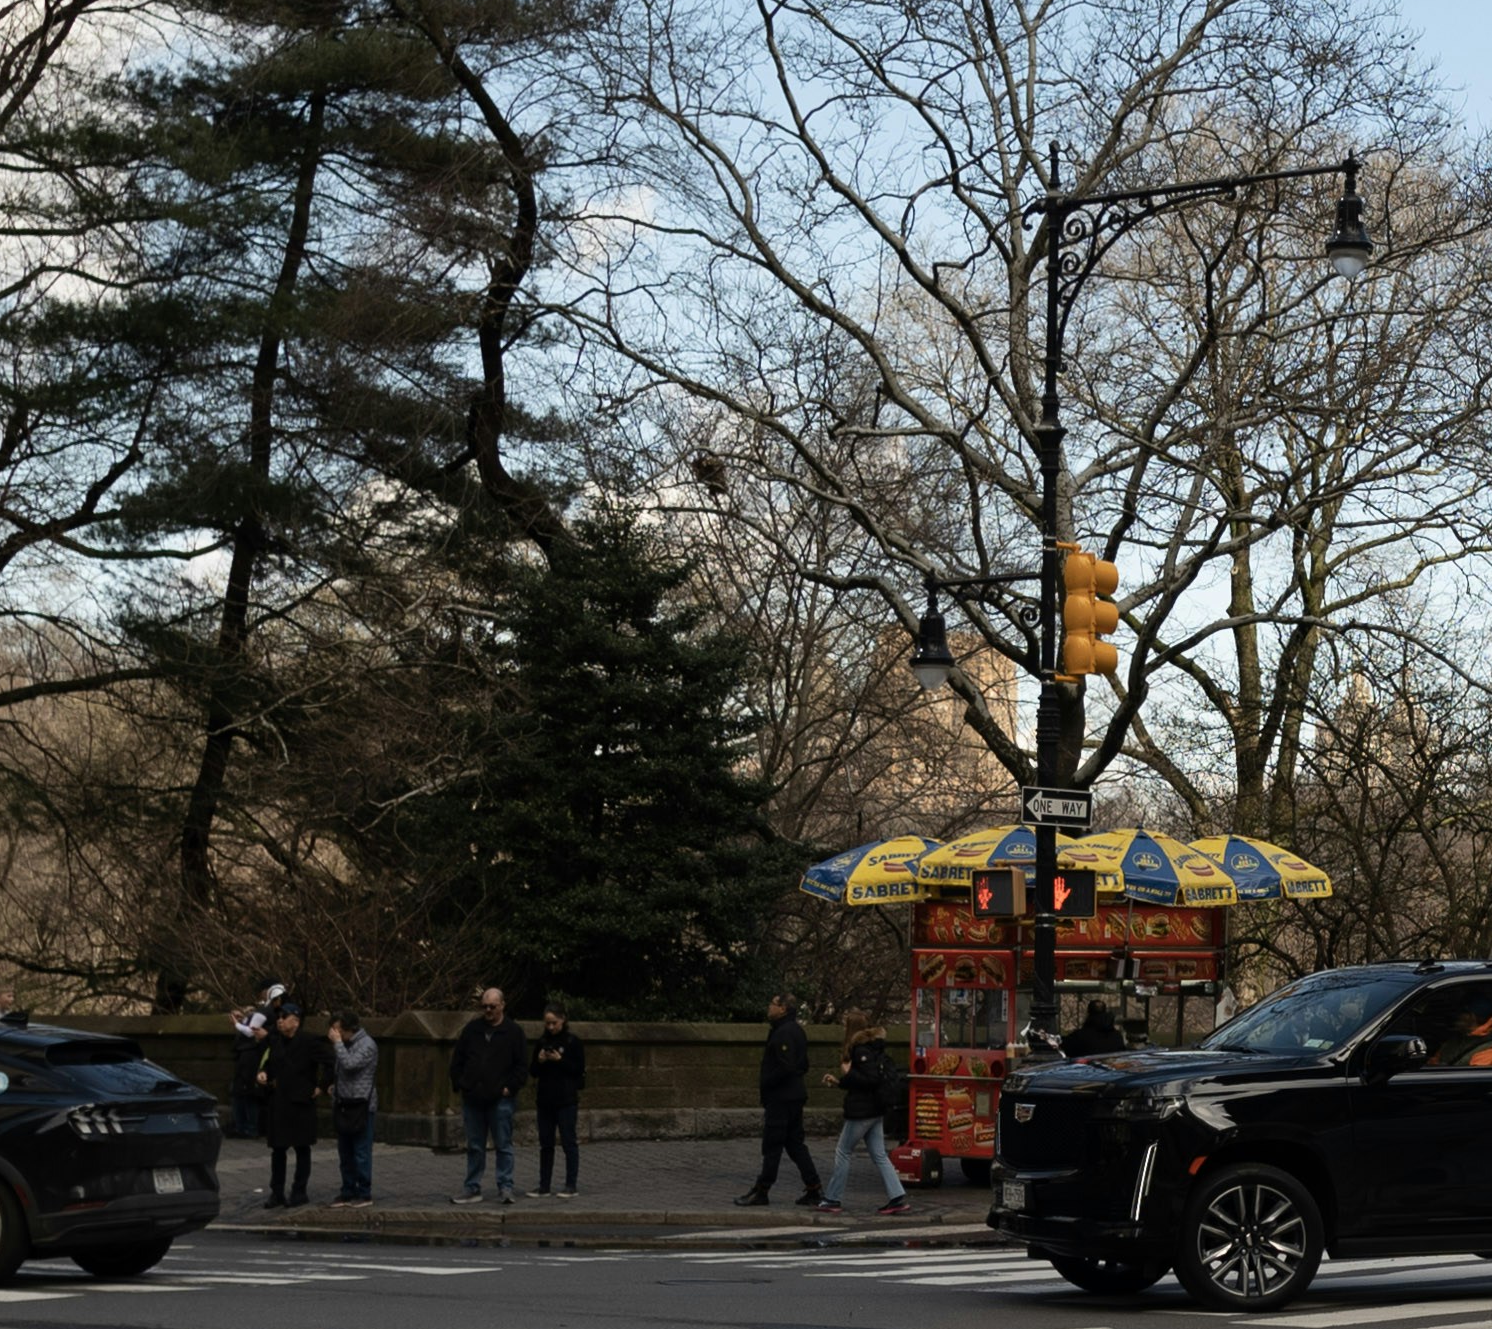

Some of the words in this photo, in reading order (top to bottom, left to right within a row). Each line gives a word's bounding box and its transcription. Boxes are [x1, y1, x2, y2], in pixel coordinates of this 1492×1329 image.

[1033, 799, 1053, 813] ONE
[1062, 802, 1084, 816] WAY
[921, 866, 973, 880] SABRET
[1185, 886, 1233, 901] SABRETT
